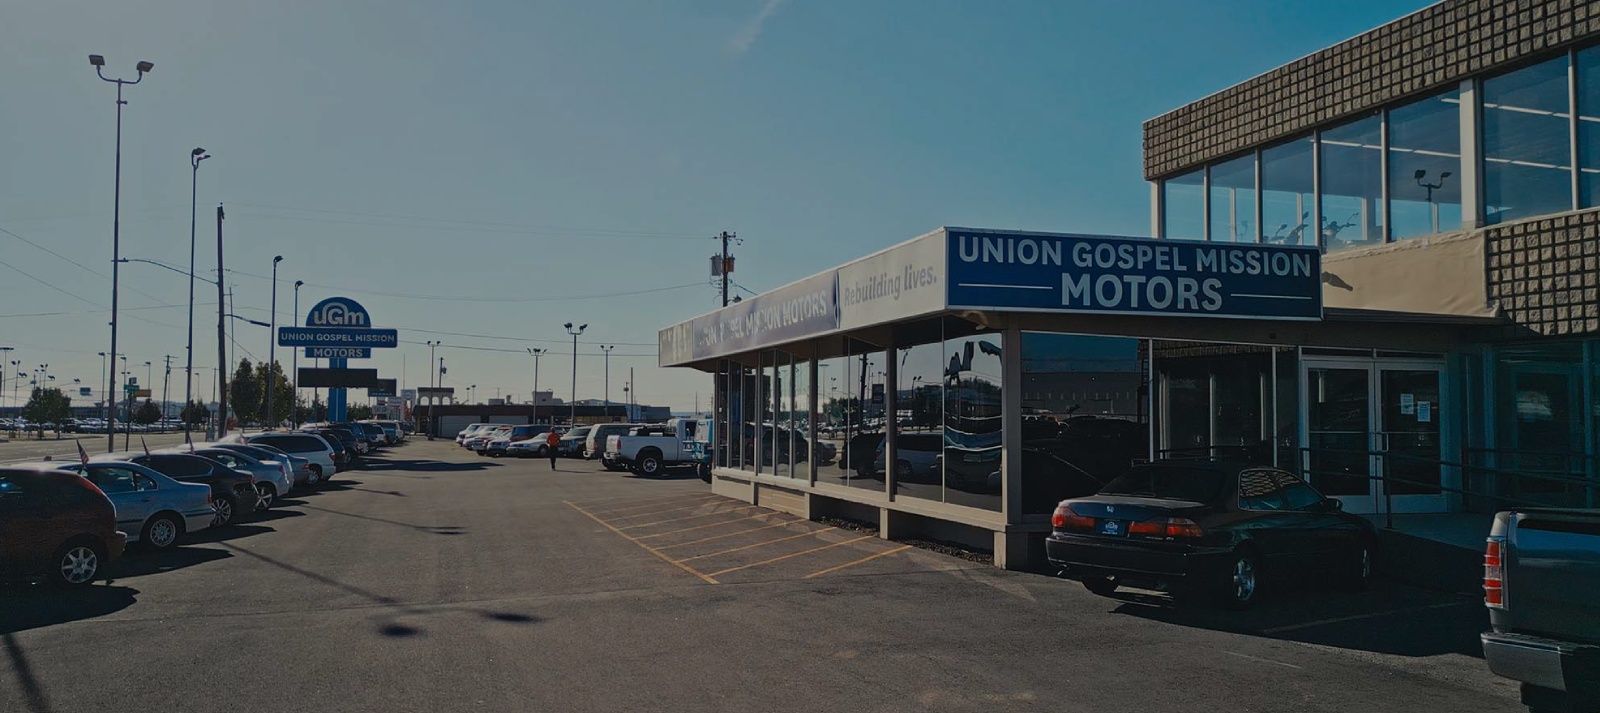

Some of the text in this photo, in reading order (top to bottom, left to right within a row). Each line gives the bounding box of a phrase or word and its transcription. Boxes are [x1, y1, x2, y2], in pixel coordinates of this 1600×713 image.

[958, 235, 1312, 278] UNION GOSPEL MISSION
[844, 263, 938, 308] Rebuilding lives.
[1061, 272, 1224, 311] MOTORS
[782, 289, 827, 327] MOTORS
[281, 332, 395, 343] UNION GOSPEL MISSION
[313, 347, 364, 358] MOTORS
